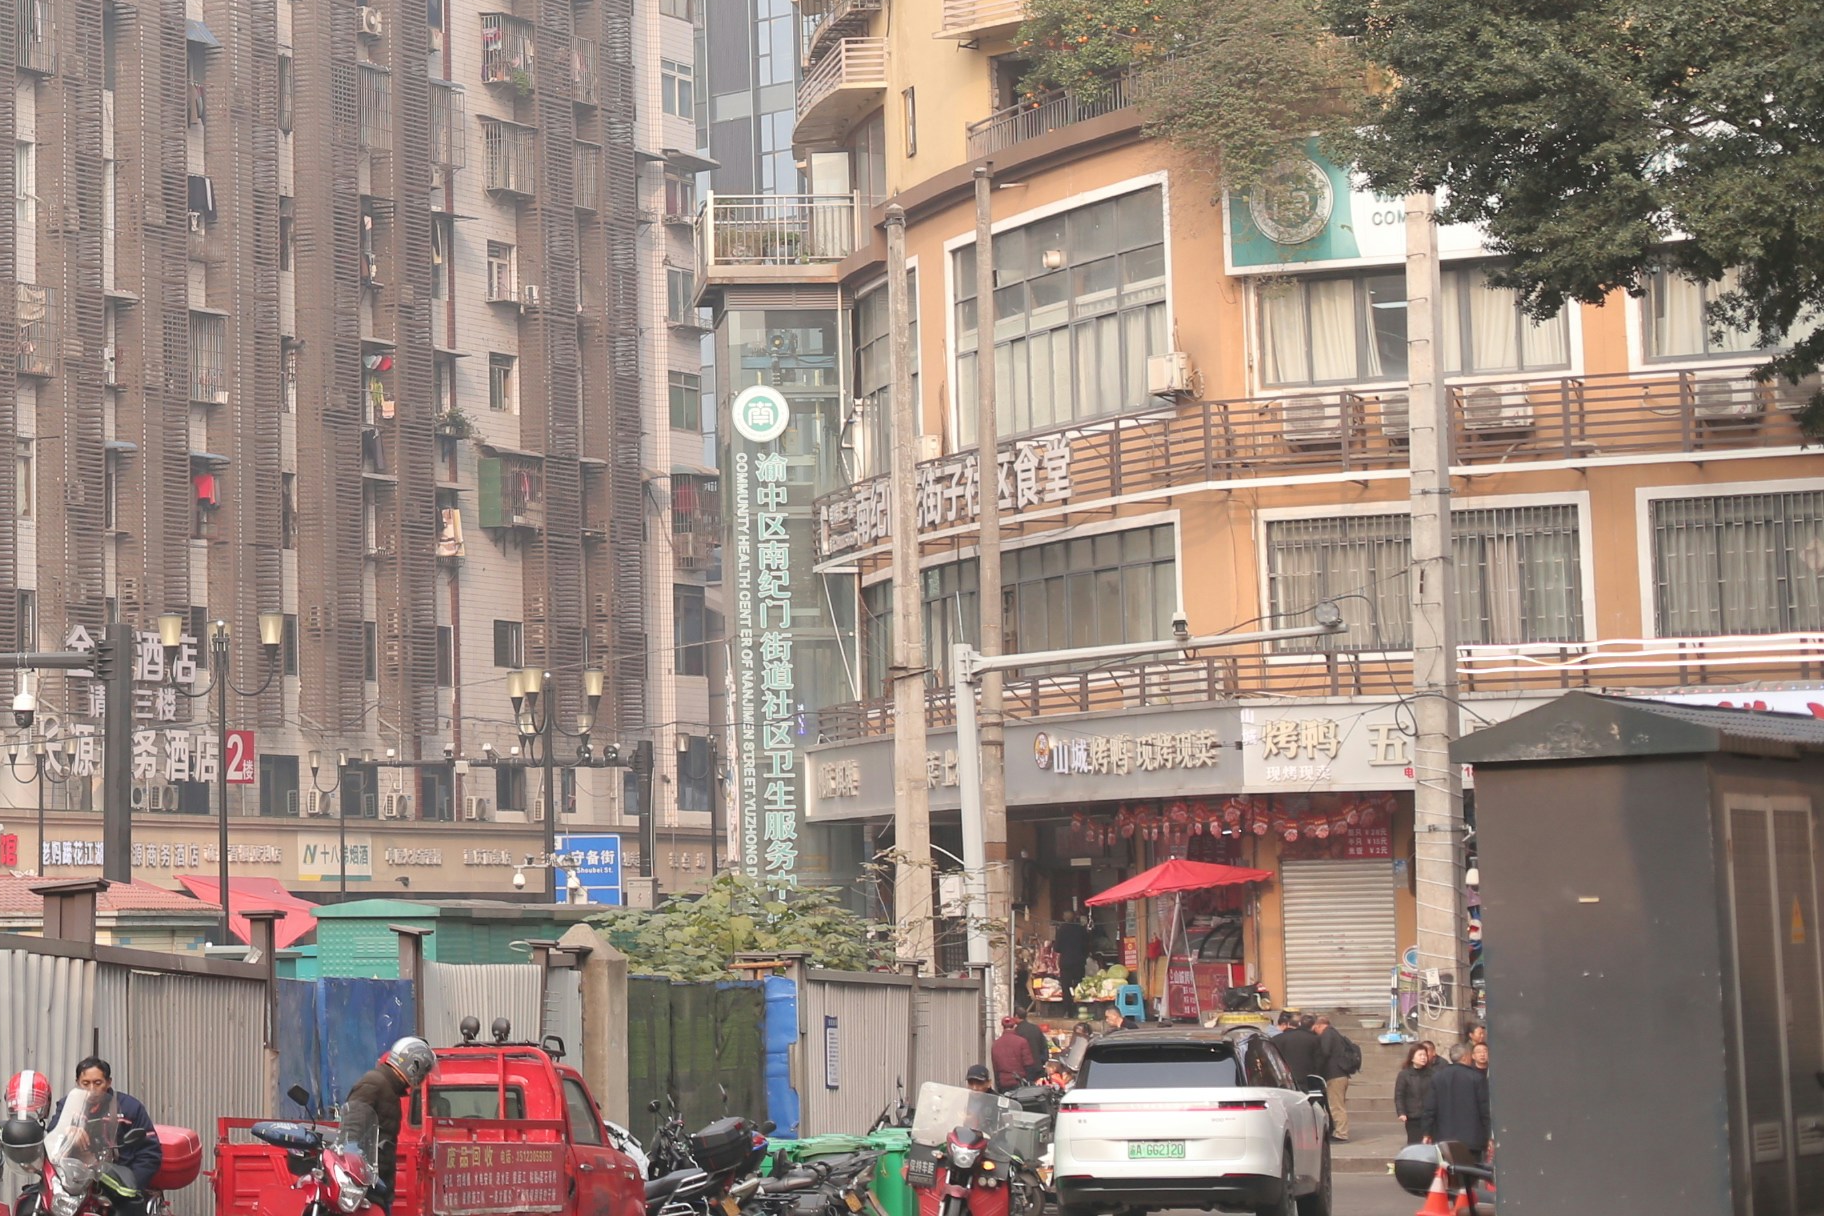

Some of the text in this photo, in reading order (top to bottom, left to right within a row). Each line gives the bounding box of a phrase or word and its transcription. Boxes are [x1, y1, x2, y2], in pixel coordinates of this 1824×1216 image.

[735, 452, 750, 534] COMMUNITY
[737, 536, 751, 588] HEALTH
[741, 650, 754, 669] OF
[88, 685, 177, 721] 请三楼
[755, 452, 798, 922] 渝中区南纪门街道社区卫生服务中
[45, 724, 220, 783] 长源务酒店
[1053, 734, 1131, 775] 山城烤鸭
[1262, 718, 1340, 760] 烤鸭
[571, 850, 615, 866] 守备街
[447, 1146, 493, 1168] 废品回收
